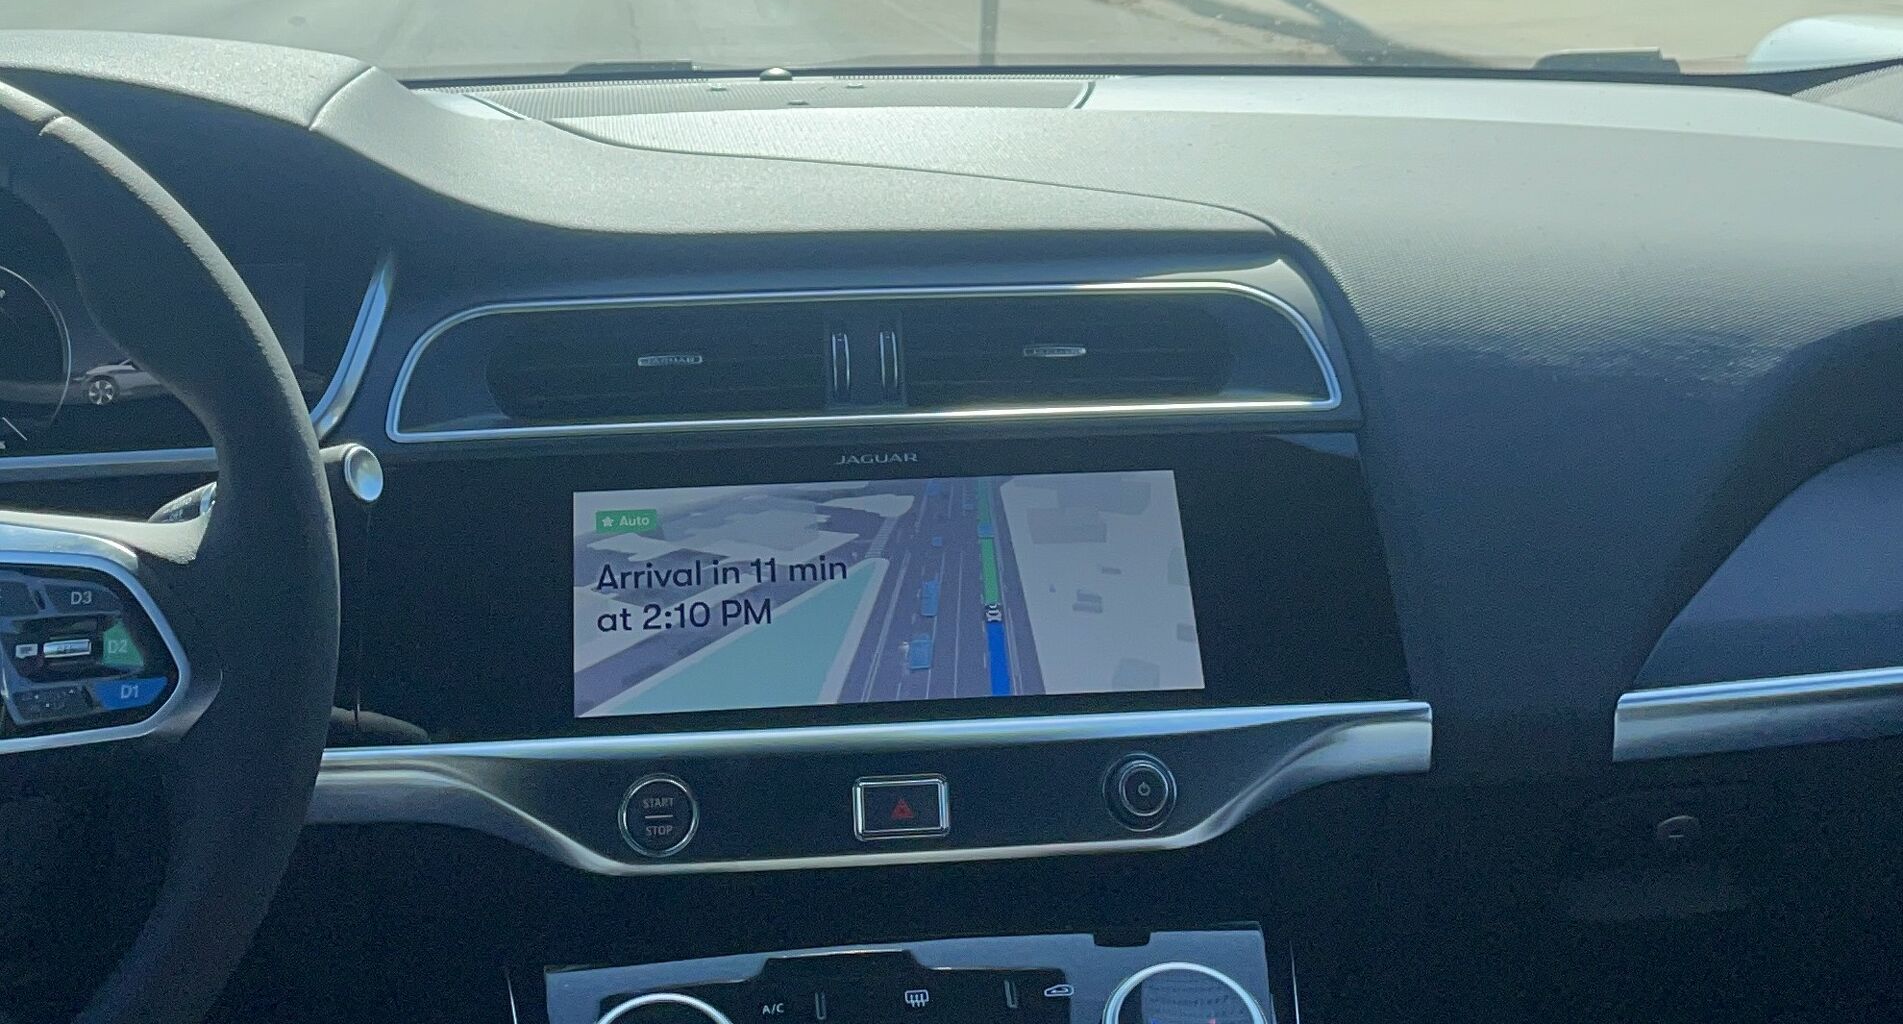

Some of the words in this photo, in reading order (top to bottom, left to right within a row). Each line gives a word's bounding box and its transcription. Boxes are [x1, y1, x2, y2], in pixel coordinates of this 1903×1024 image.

[835, 452, 919, 465] JAGUAR
[619, 514, 650, 527] Auto
[596, 559, 701, 591] Arrival
[713, 559, 740, 585] in
[750, 557, 777, 584] 11
[788, 554, 848, 582] min
[70, 590, 93, 605] D3
[596, 607, 632, 633] at
[642, 600, 711, 631] 2:10
[721, 597, 773, 627] PM
[107, 638, 129, 654] D2
[120, 684, 139, 699] D1
[642, 797, 674, 809] START
[645, 824, 673, 836] STOP
[762, 1002, 785, 1015] A/C
